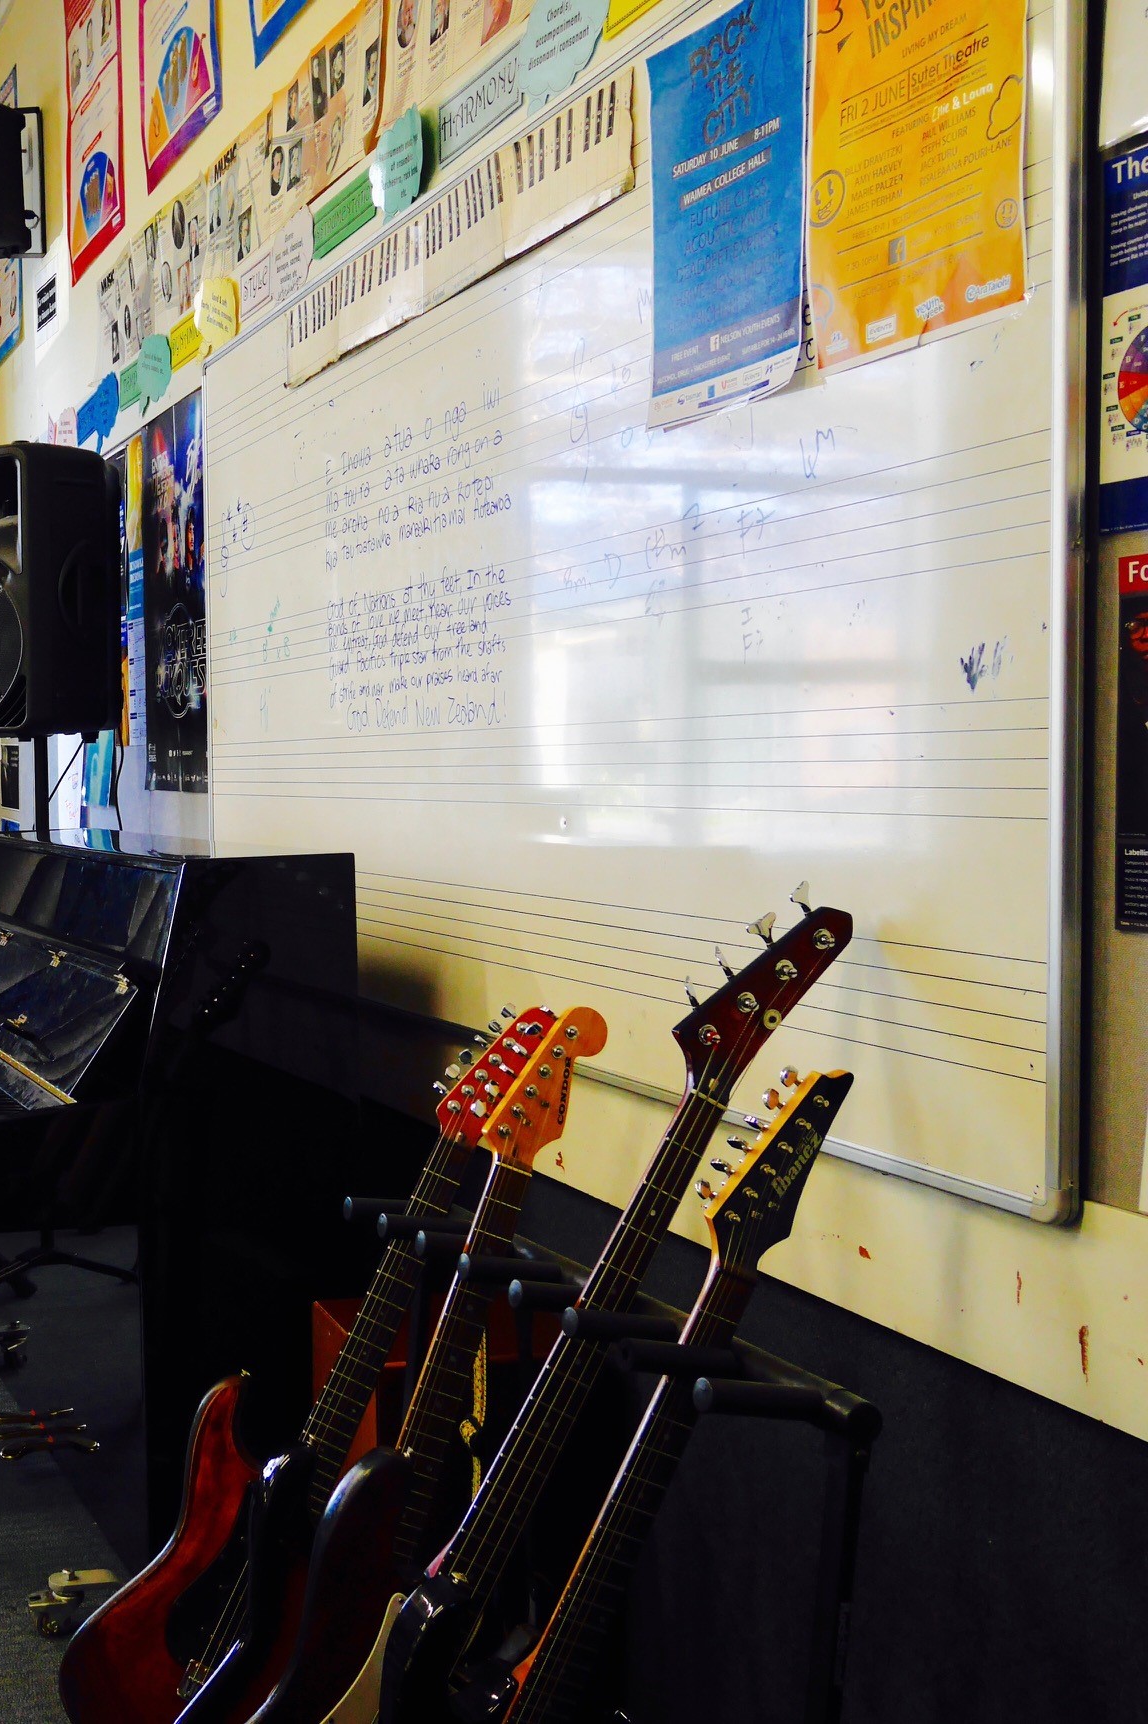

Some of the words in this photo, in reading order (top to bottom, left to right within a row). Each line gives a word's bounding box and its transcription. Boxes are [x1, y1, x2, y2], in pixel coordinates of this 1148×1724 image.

[535, 11, 582, 48] accompaniment,
[689, 4, 758, 77] ROCK
[902, 38, 926, 59] LIVING
[927, 32, 939, 45] MY
[941, 13, 968, 35] DREAM
[911, 61, 939, 87] Suter
[943, 35, 990, 70] Theatre
[441, 57, 518, 142] HARMONY
[840, 103, 858, 127] FRI
[861, 98, 869, 117] 2
[871, 78, 906, 112] JUNE
[892, 112, 930, 139] FEATURING
[952, 96, 960, 110] &
[938, 106, 976, 133] WILLIAMS
[673, 153, 707, 178] SATURDAY
[710, 149, 718, 161] 10
[720, 138, 739, 158] JUNE
[754, 117, 780, 140] 8-11PM
[920, 137, 940, 157] STEPH
[941, 126, 968, 145] SCURR
[683, 183, 712, 206] WAIMEA
[714, 163, 746, 189] COLLEGE
[748, 152, 767, 174] HALL
[851, 187, 874, 202] MARIE
[875, 174, 903, 194] PALZER
[854, 172, 872, 187] AMY
[872, 161, 903, 178] HARVEY
[846, 203, 870, 219] JAMES
[871, 190, 903, 210] PERHAM
[671, 348, 685, 363] FREE
[686, 345, 699, 360] EVENT
[720, 331, 741, 345] NELSON
[742, 322, 758, 338] YOUTH
[758, 313, 780, 331] EVENTS
[384, 424, 412, 458] atua
[444, 401, 466, 442] nga
[327, 596, 345, 621] God
[348, 592, 361, 616] of
[363, 589, 396, 613] Nations
[417, 571, 436, 598] thy
[467, 569, 481, 590] In
[485, 562, 506, 584] the
[368, 613, 384, 630] love
[457, 596, 475, 616] our
[483, 590, 512, 612] voices
[329, 656, 350, 681] Guard
[389, 650, 410, 674] triple
[432, 642, 453, 664] from
[455, 637, 473, 657] the
[478, 632, 507, 656] shafts
[392, 622, 419, 649] defend
[423, 623, 441, 640] our
[446, 618, 465, 636] free
[468, 617, 488, 633] land
[330, 681, 338, 709] of
[339, 681, 356, 704] strife
[389, 675, 408, 694] make
[411, 673, 422, 688] our
[426, 668, 453, 693] praises
[347, 703, 369, 732] God
[375, 695, 408, 728] Defend
[416, 699, 440, 727] New
[557, 1056, 572, 1125] CONDOR
[772, 1131, 822, 1198] Ibanez
